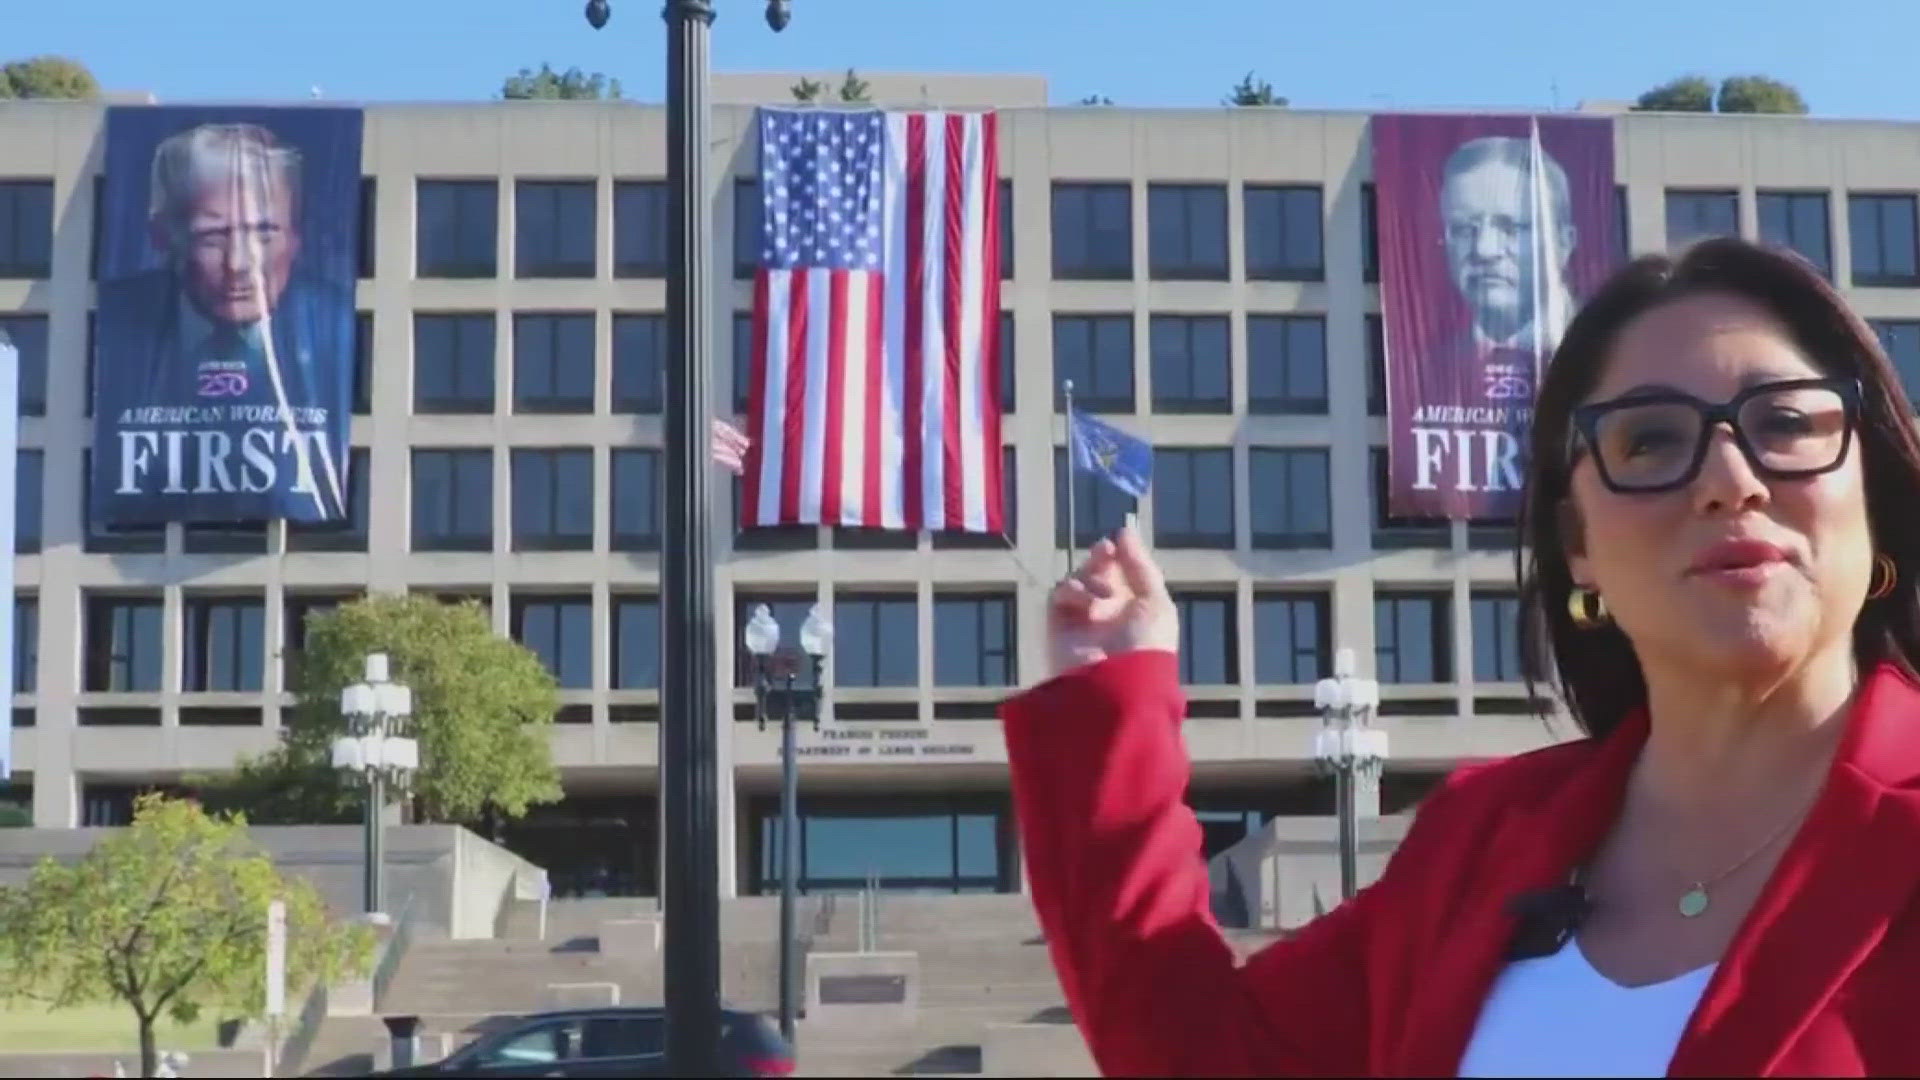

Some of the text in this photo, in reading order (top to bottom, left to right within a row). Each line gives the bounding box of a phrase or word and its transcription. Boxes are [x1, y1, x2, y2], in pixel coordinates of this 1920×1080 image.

[197, 373, 249, 397] 250
[117, 405, 223, 425] AMERICAN
[1412, 404, 1510, 424] AMERICAN
[114, 427, 328, 494] FIRST
[1411, 427, 1523, 491] FIR
